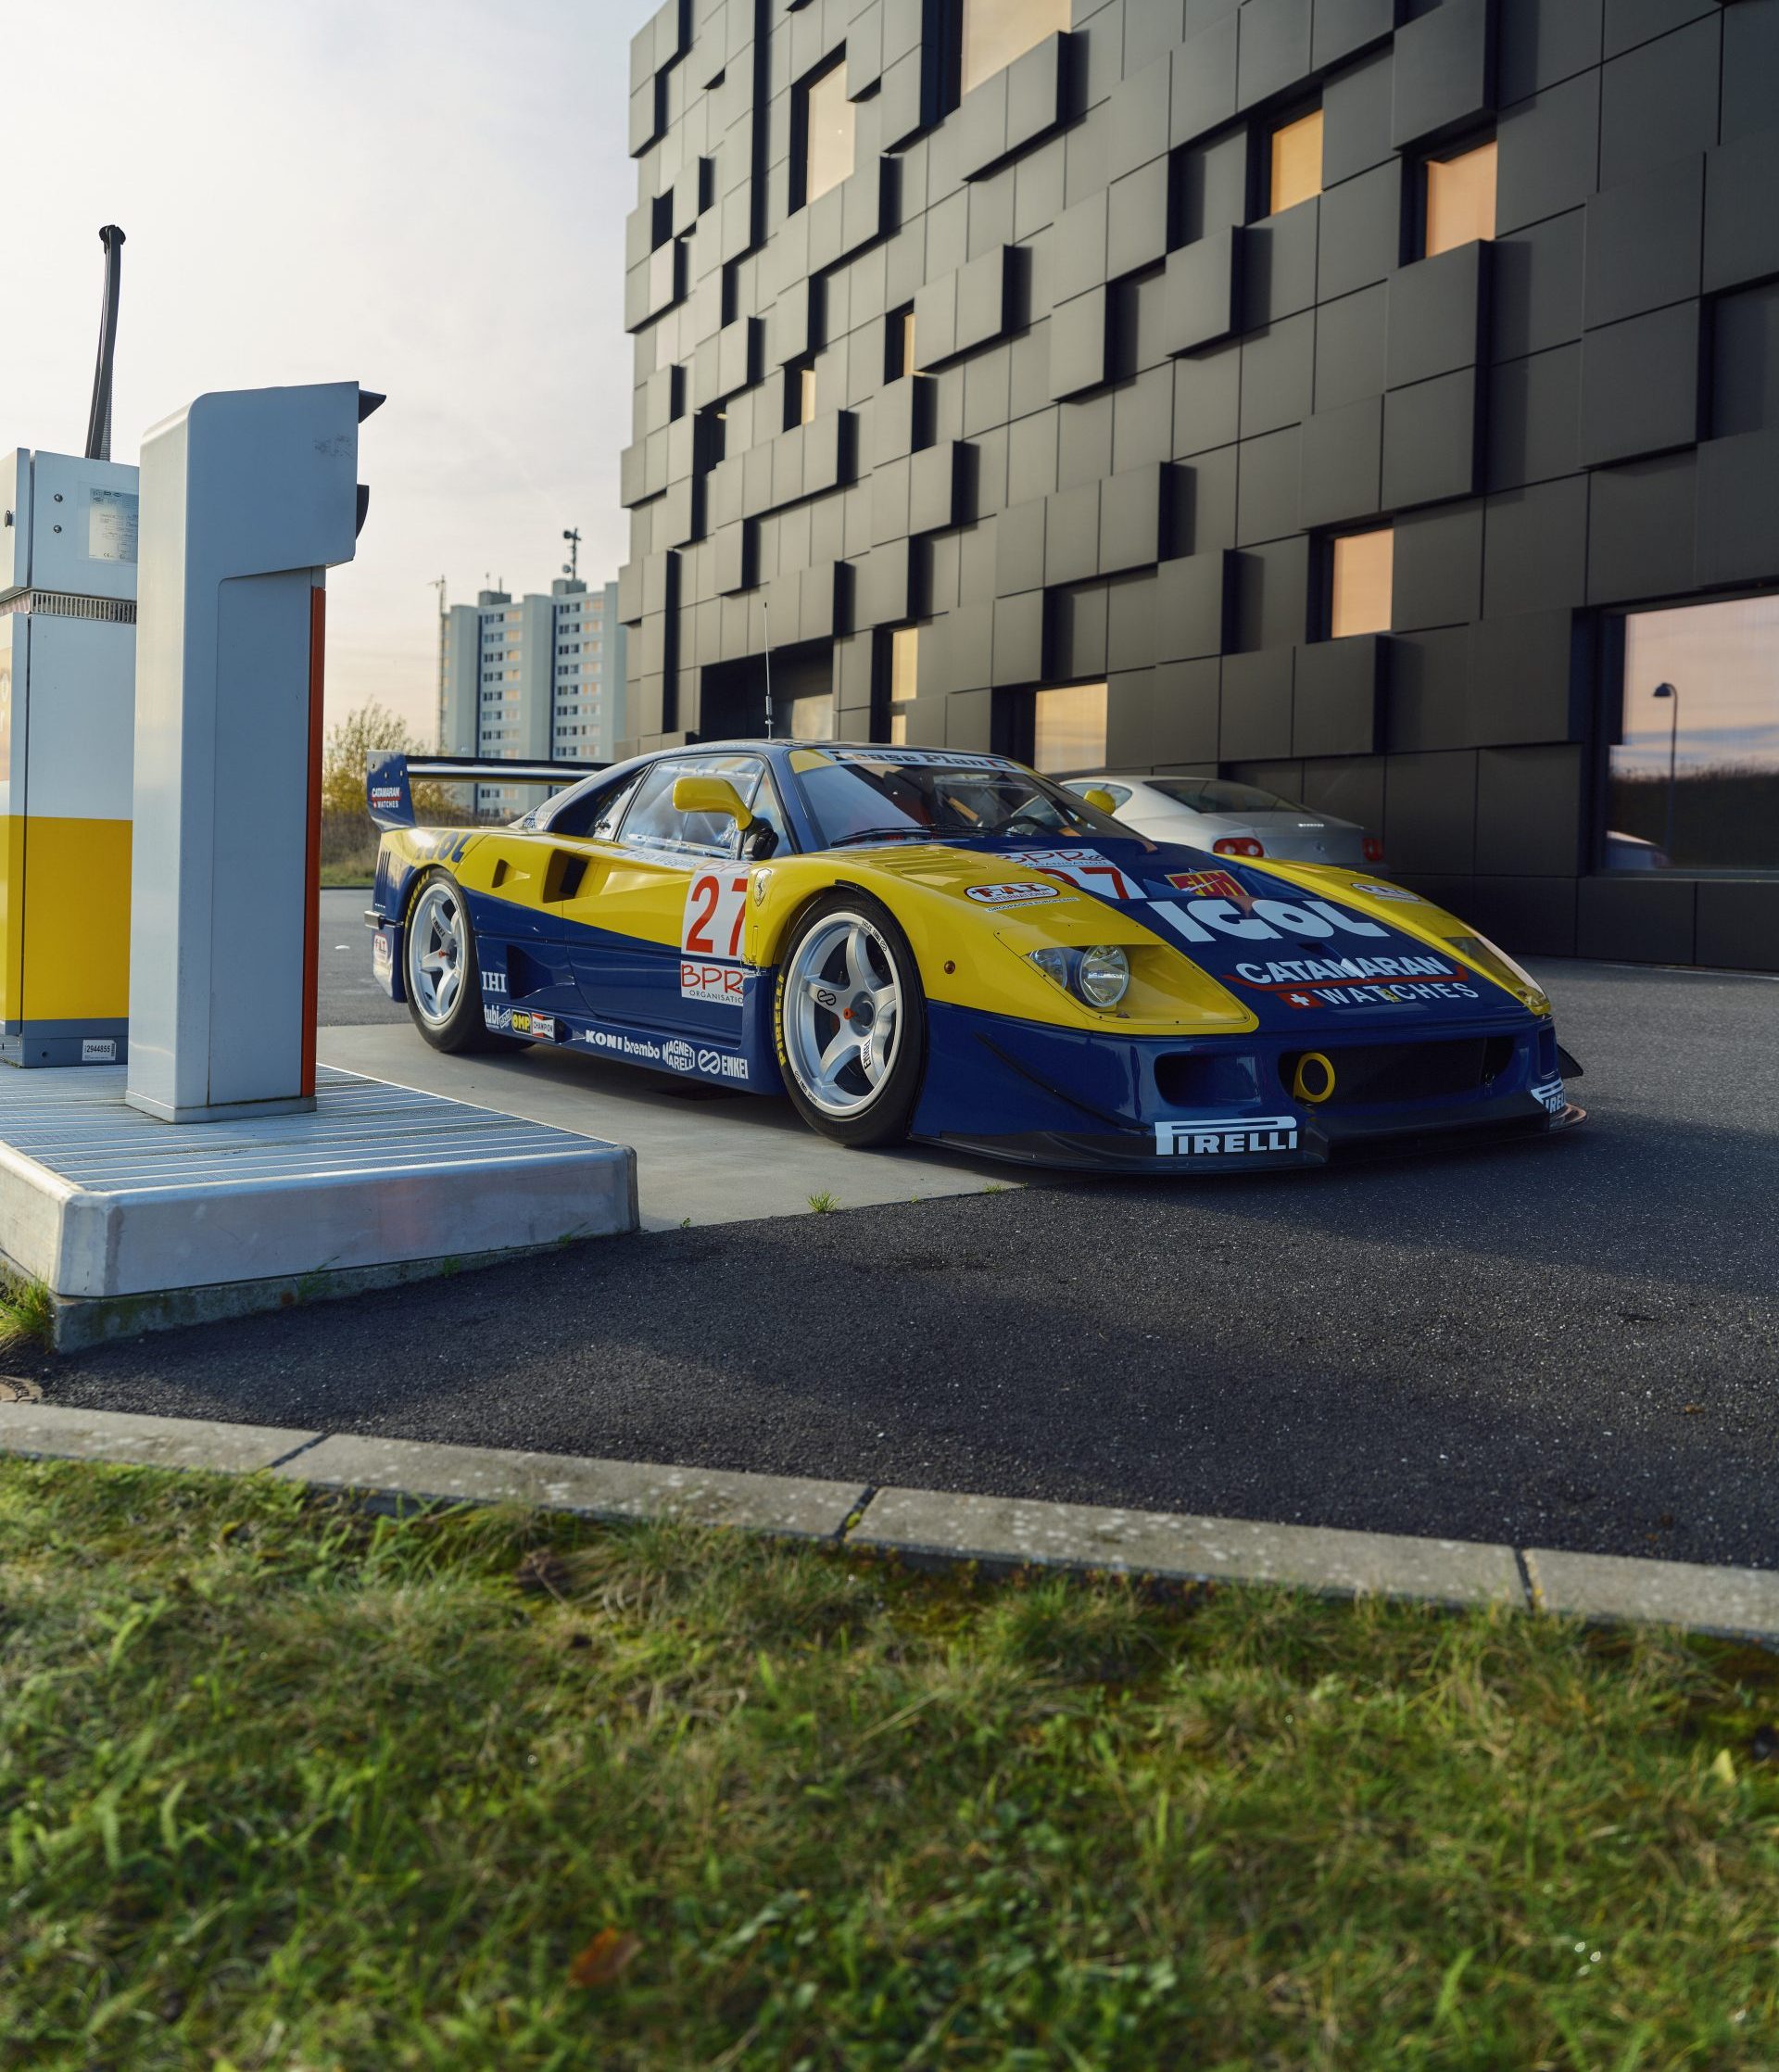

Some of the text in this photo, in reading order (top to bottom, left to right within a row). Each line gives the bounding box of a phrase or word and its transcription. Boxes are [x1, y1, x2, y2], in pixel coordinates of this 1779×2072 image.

[920, 754, 987, 766] Plan
[372, 787, 400, 798] CATAMARAN
[377, 800, 398, 808] WATCHES
[686, 876, 748, 956] 27
[1146, 899, 1390, 941] IGOL
[682, 965, 743, 994] BPR
[1236, 957, 1453, 983] CATAMARAN
[482, 971, 507, 992] IHI
[1313, 983, 1479, 1004] WATCHES
[484, 1004, 499, 1025] tubi
[586, 1030, 622, 1050] KONI
[624, 1037, 660, 1059] brembo
[722, 1055, 749, 1080] ENKEI
[1154, 1116, 1297, 1155] PIRELLI
